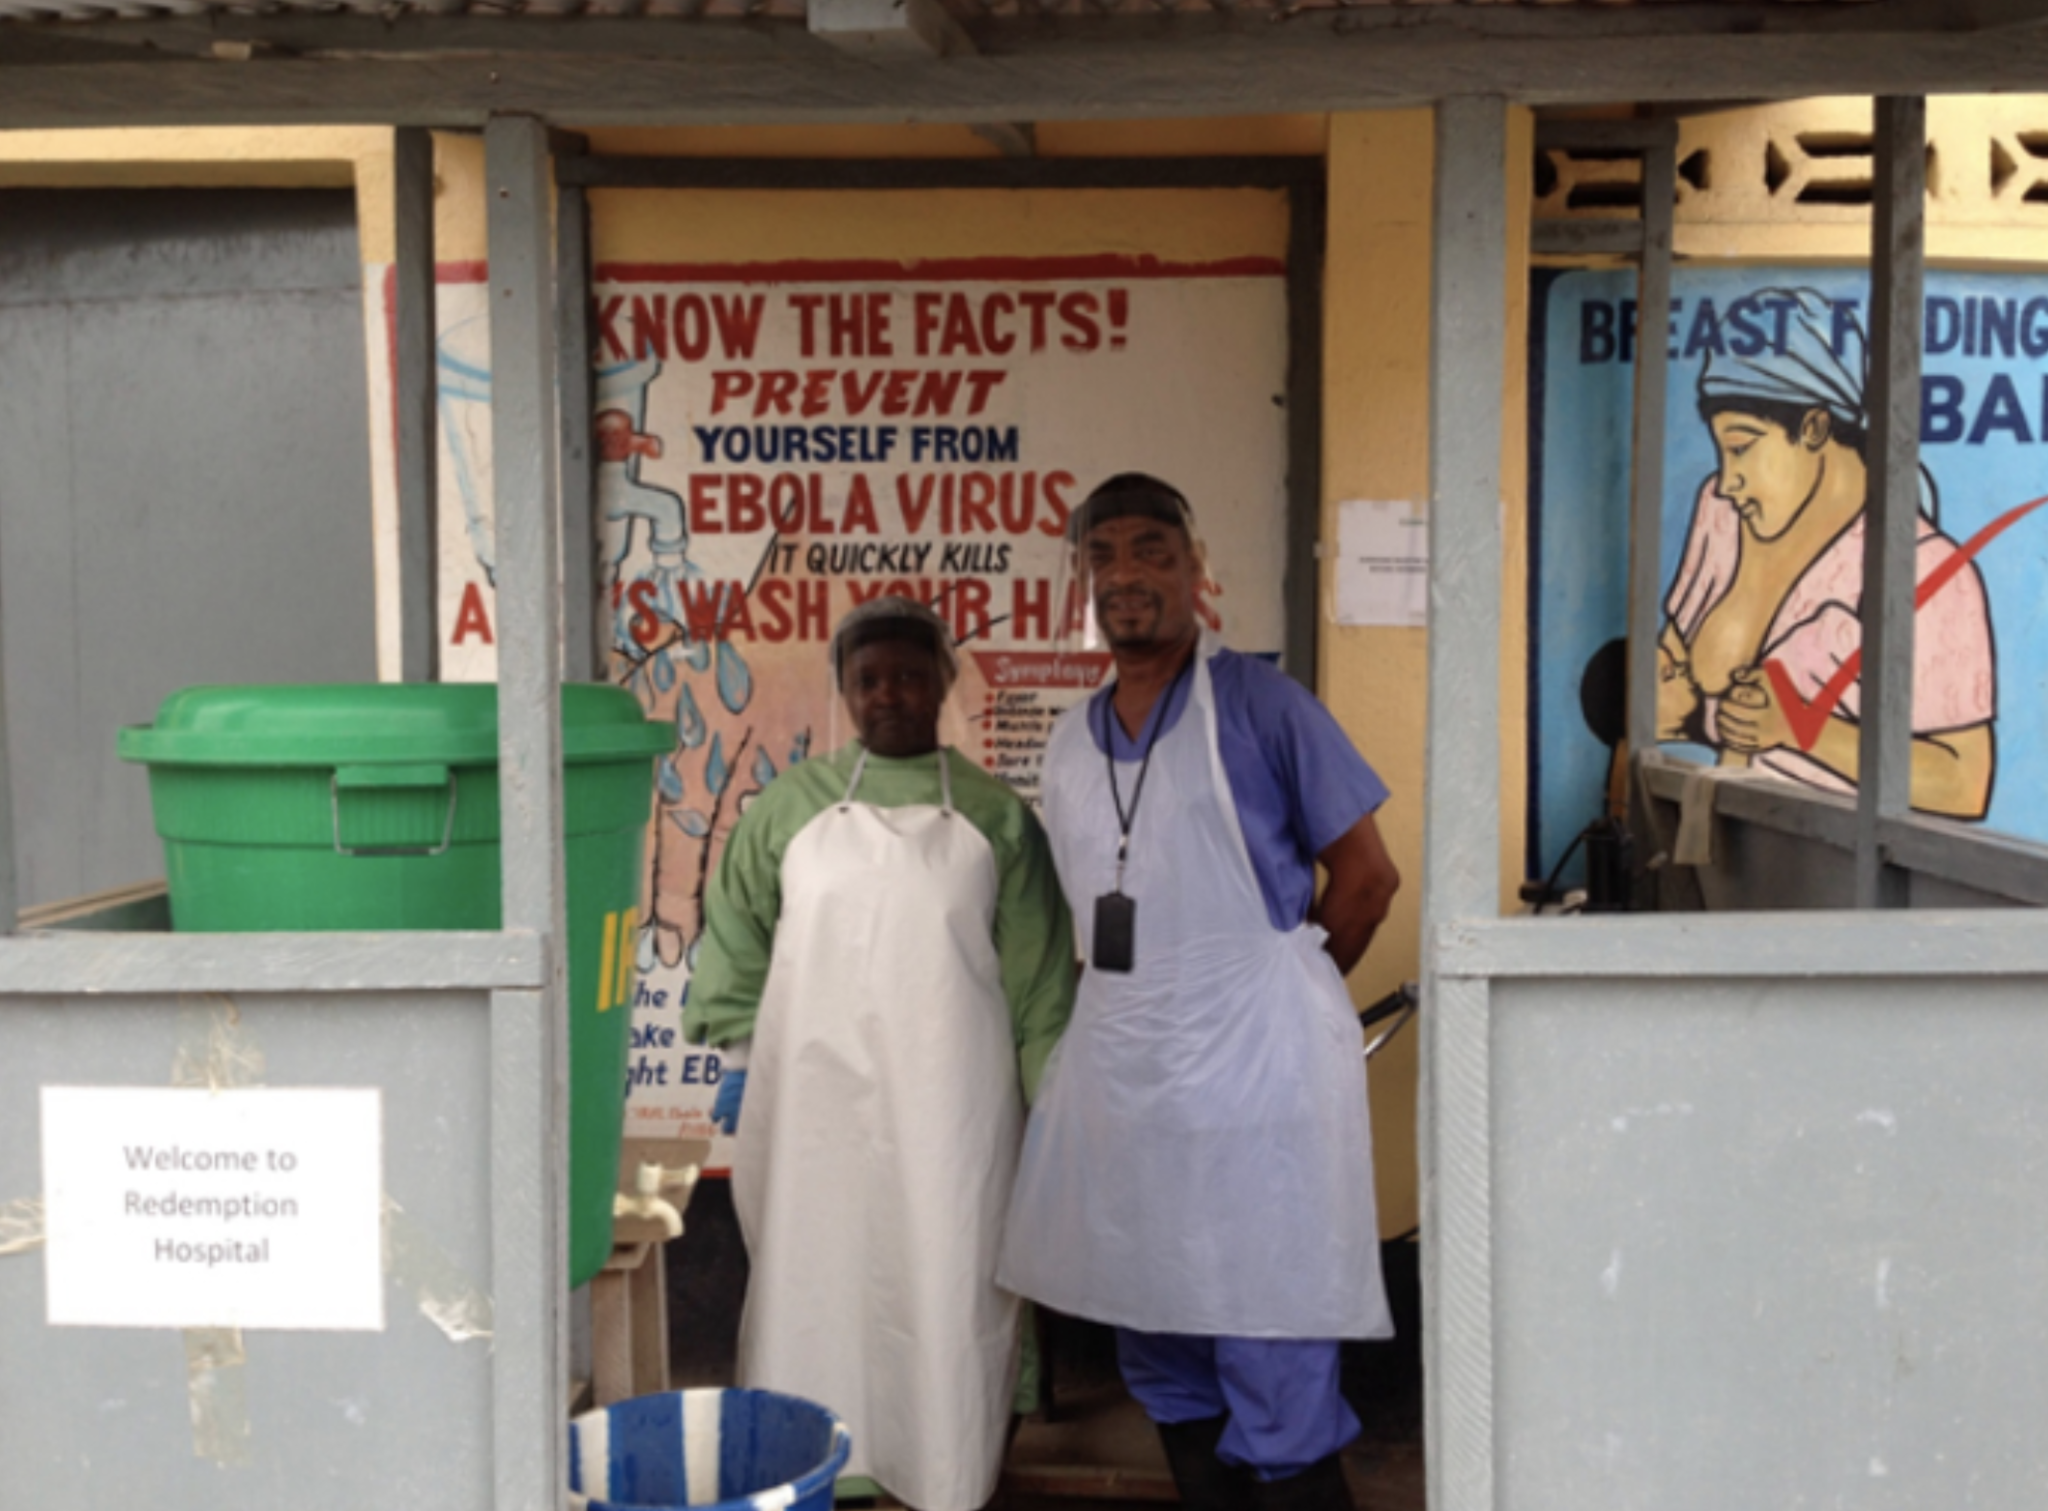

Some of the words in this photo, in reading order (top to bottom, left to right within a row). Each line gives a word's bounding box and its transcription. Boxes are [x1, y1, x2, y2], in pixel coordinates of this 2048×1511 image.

[593, 291, 766, 364] KNOW
[788, 292, 893, 358] THE
[914, 287, 1129, 356] FACTS!
[709, 368, 1007, 419] PREVENT
[1920, 372, 2048, 444] BA
[693, 424, 898, 464] YOURSELF
[911, 425, 1019, 463] FROM
[688, 470, 880, 536] EBOLA
[896, 469, 1077, 538] VIRUS
[769, 542, 799, 575] IT
[806, 541, 931, 577] QUICKLY
[939, 541, 1012, 576] KILLS
[676, 578, 829, 643] WASH
[122, 1145, 259, 1171] Welcome
[267, 1149, 298, 1172] to
[123, 1190, 299, 1222] Redemption
[153, 1238, 270, 1267] Hospital
